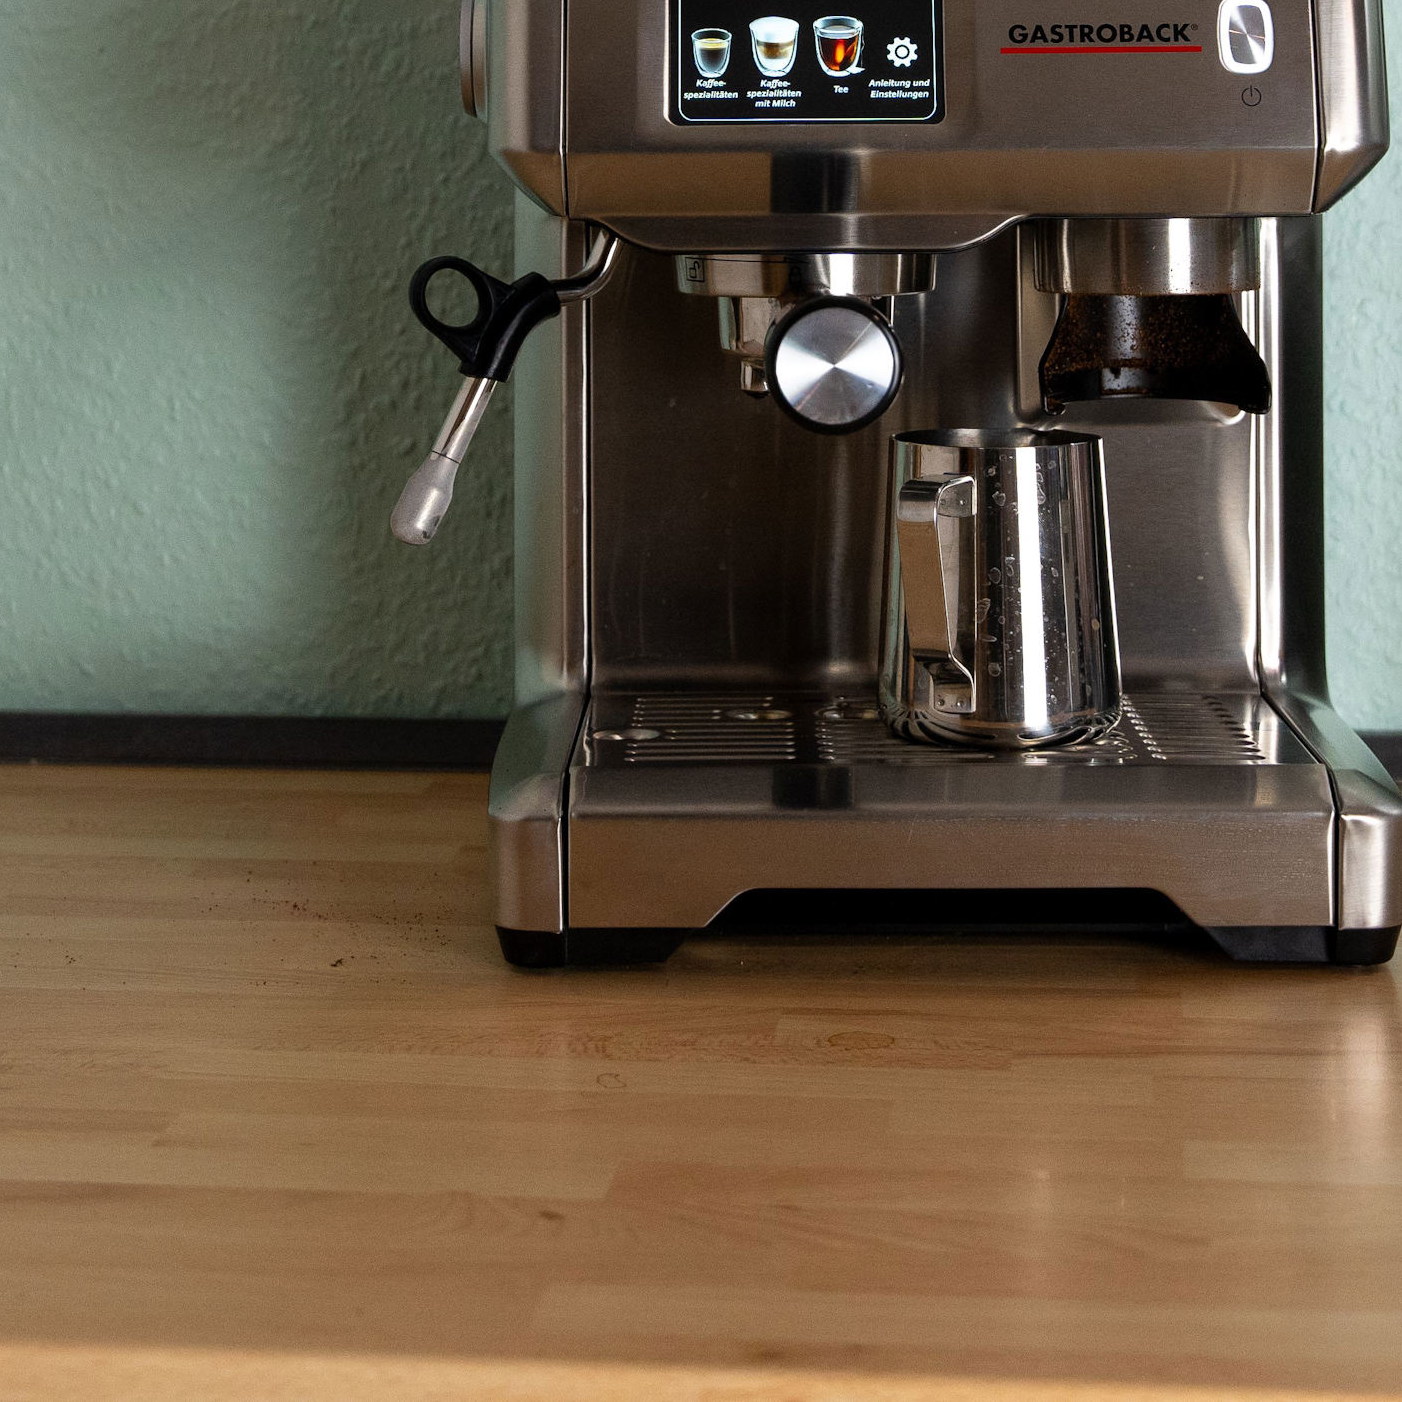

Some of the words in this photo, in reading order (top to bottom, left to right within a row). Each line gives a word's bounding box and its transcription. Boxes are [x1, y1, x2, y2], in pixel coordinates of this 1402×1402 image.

[696, 79, 726, 88] Kaffee-
[760, 79, 790, 88] Kaffee-
[868, 79, 911, 89] Anleitung
[912, 79, 930, 87] und
[746, 89, 802, 98] spezialitäten
[833, 85, 849, 93] Tee
[683, 91, 738, 100] spezialitäten
[870, 90, 929, 99] Einstellungen
[755, 99, 771, 107] mit
[772, 99, 796, 107] Milch
